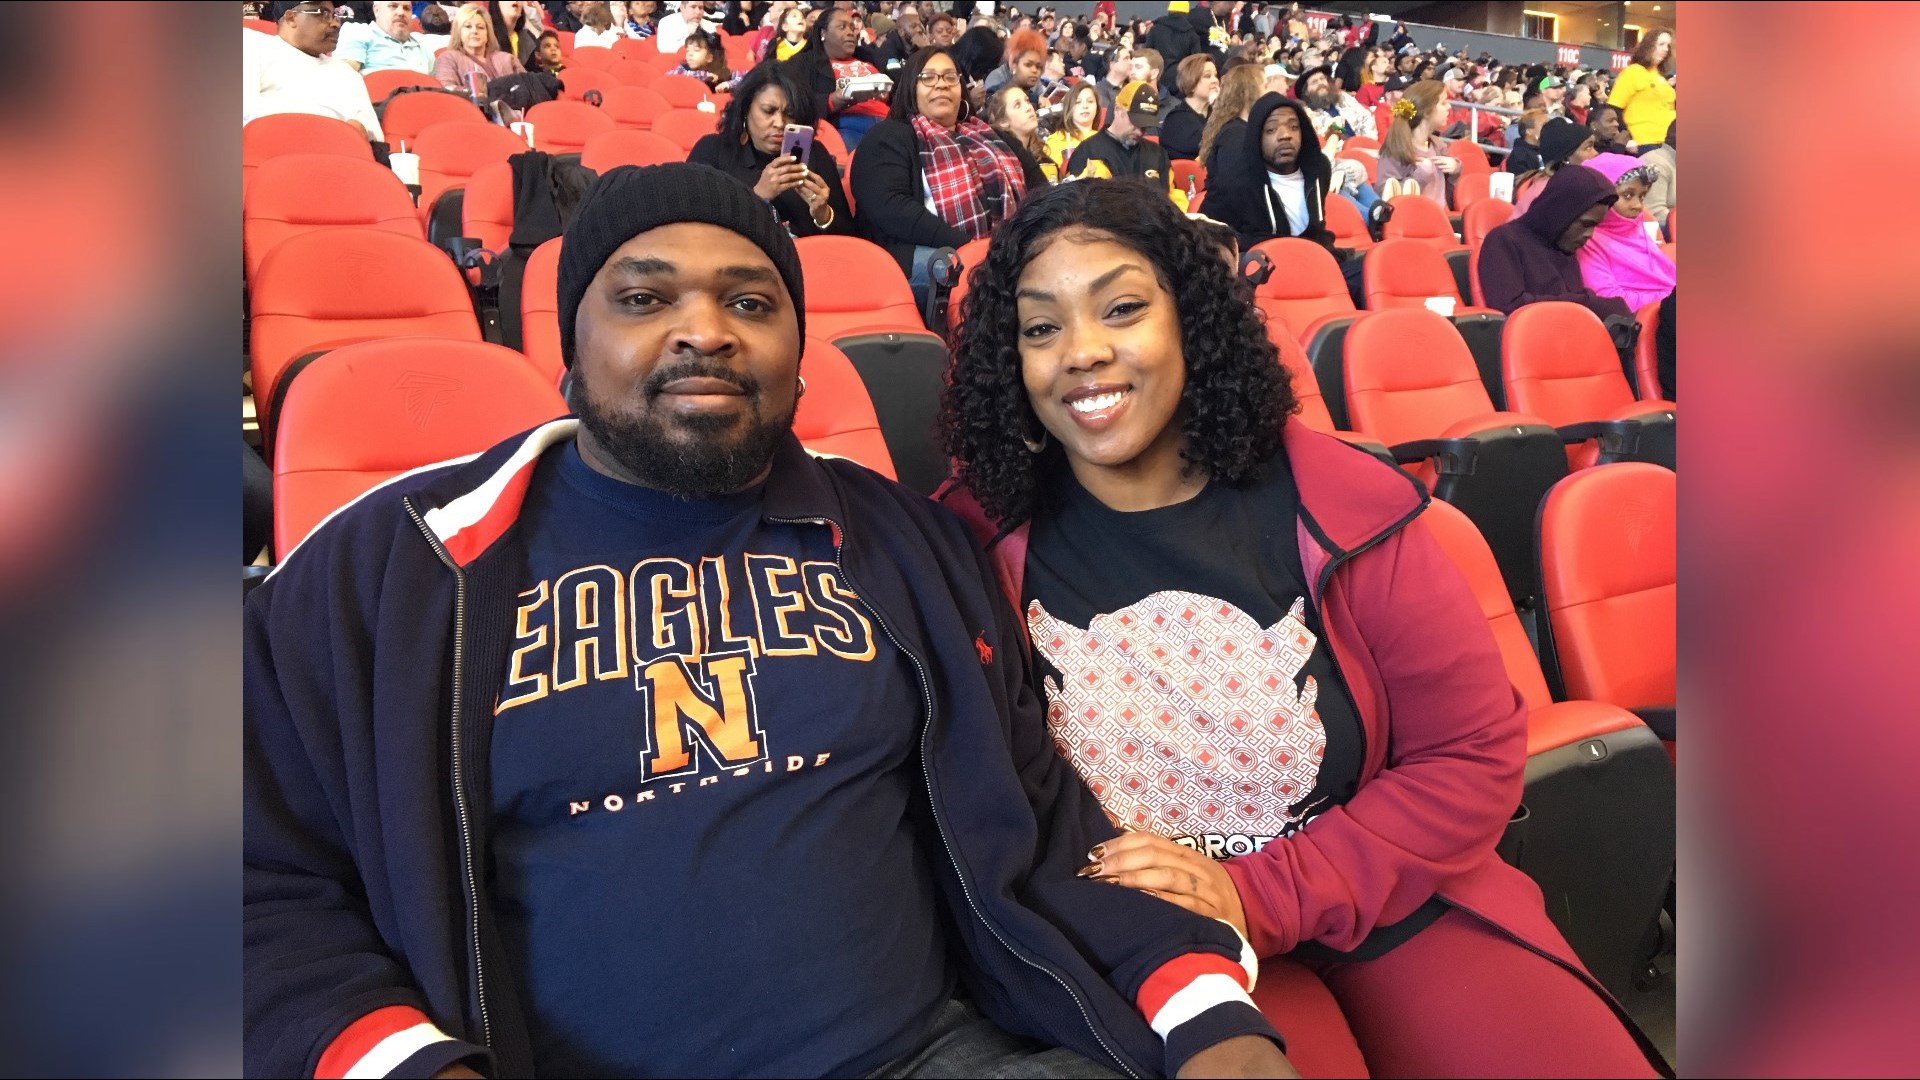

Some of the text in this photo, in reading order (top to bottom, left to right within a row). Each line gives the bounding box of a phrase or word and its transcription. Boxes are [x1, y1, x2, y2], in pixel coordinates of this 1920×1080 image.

[1558, 47, 1580, 64] 110C
[494, 553, 877, 715] EAGLES
[634, 651, 769, 783] N
